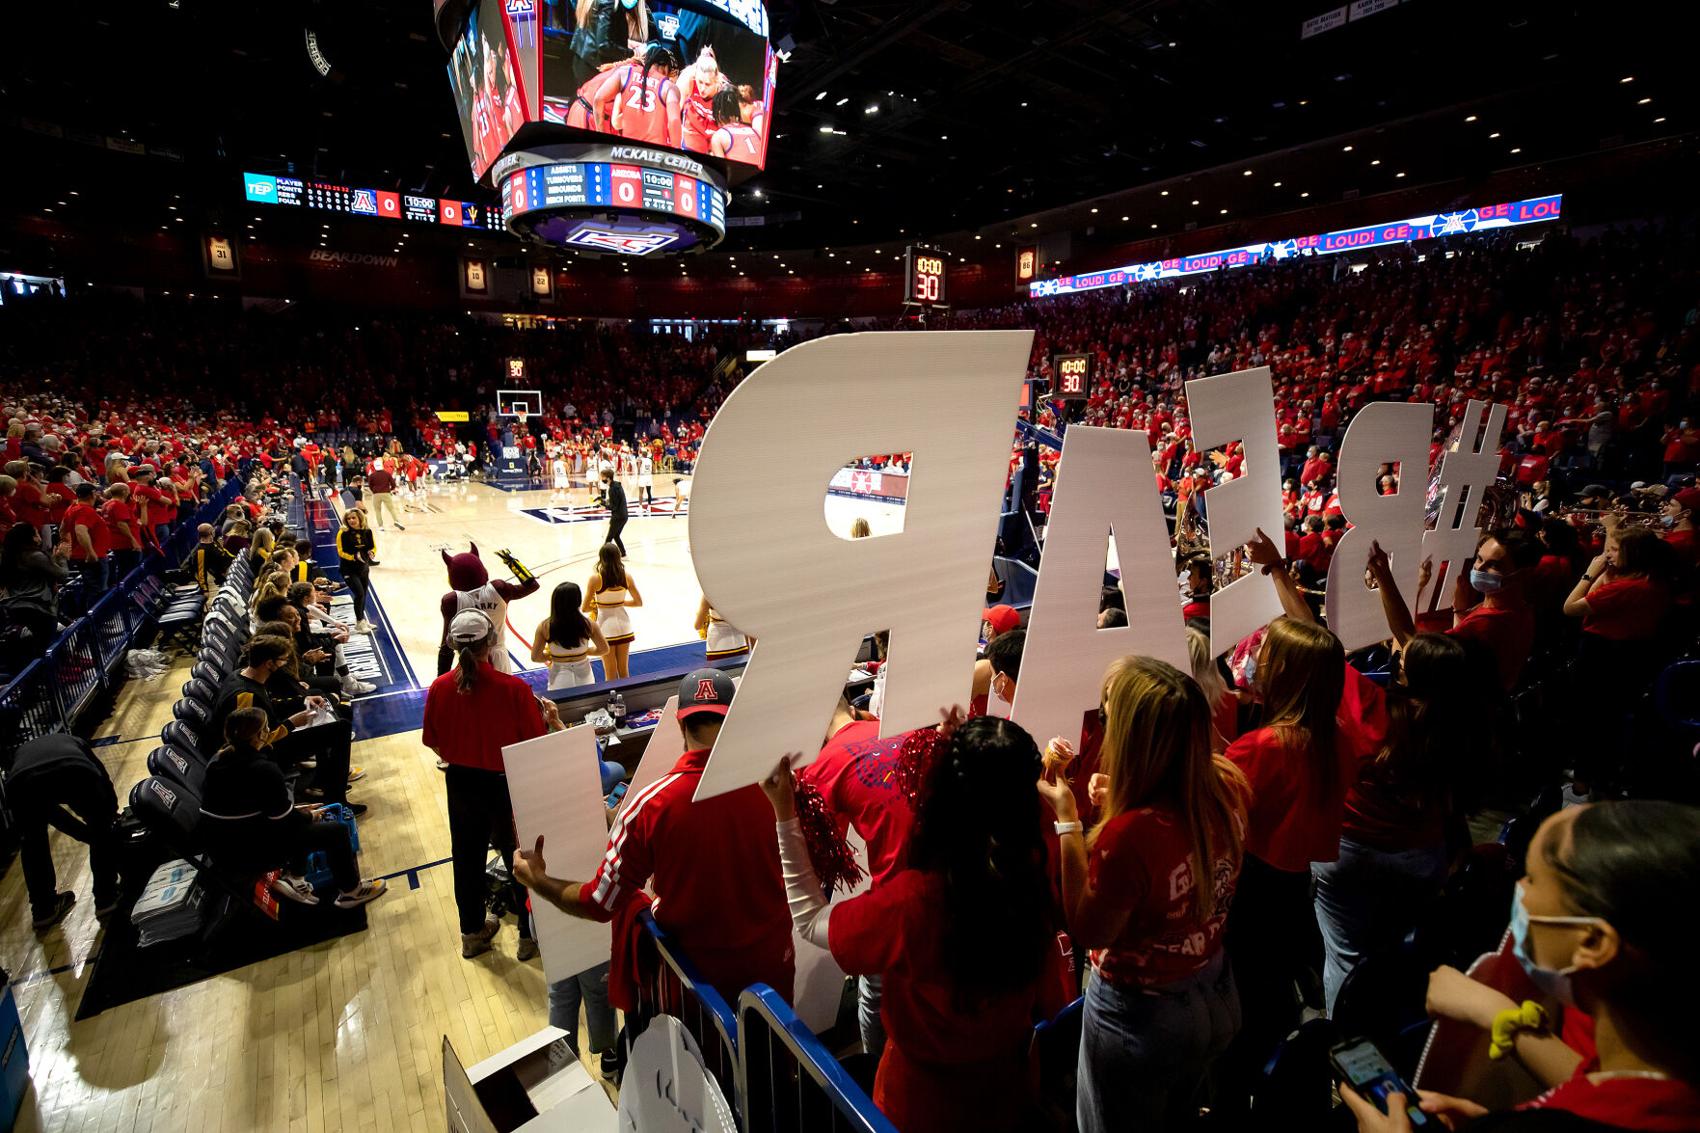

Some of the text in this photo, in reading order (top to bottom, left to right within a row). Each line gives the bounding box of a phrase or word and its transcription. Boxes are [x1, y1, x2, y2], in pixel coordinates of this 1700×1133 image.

[626, 86, 656, 112] 23
[610, 147, 702, 173] MCKALE CENTER
[546, 175, 582, 184] TURNOVERS
[611, 169, 641, 179] ARIZONA
[646, 175, 672, 186] 10:00
[248, 183, 272, 195] TEP
[277, 178, 303, 187] PLAYER
[277, 185, 302, 193] POINTS
[548, 185, 582, 194] REBOUNDS
[515, 190, 524, 208] 0
[619, 182, 635, 202] 0
[278, 197, 301, 205] FOULS
[352, 190, 376, 213] A
[384, 199, 394, 210] 0
[408, 197, 433, 208] 10:00
[681, 192, 693, 211] 0
[444, 207, 454, 218] 0
[1480, 203, 1514, 218] GE
[1298, 234, 1322, 248] GE
[1326, 231, 1375, 249] LOUD!
[1383, 224, 1413, 240] GE
[217, 250, 226, 258] 31
[1163, 258, 1182, 269] GE
[1185, 256, 1222, 271] LOUD!
[1228, 251, 1250, 263] GE
[917, 258, 942, 275] 10:00
[1059, 277, 1074, 286] GE
[1076, 275, 1104, 287] LOUD!
[1109, 272, 1126, 282] GE
[917, 274, 938, 300] 30
[511, 367, 522, 376] 30
[1062, 360, 1085, 373] 10:00
[1064, 375, 1079, 392] 30
[694, 678, 717, 700] A
